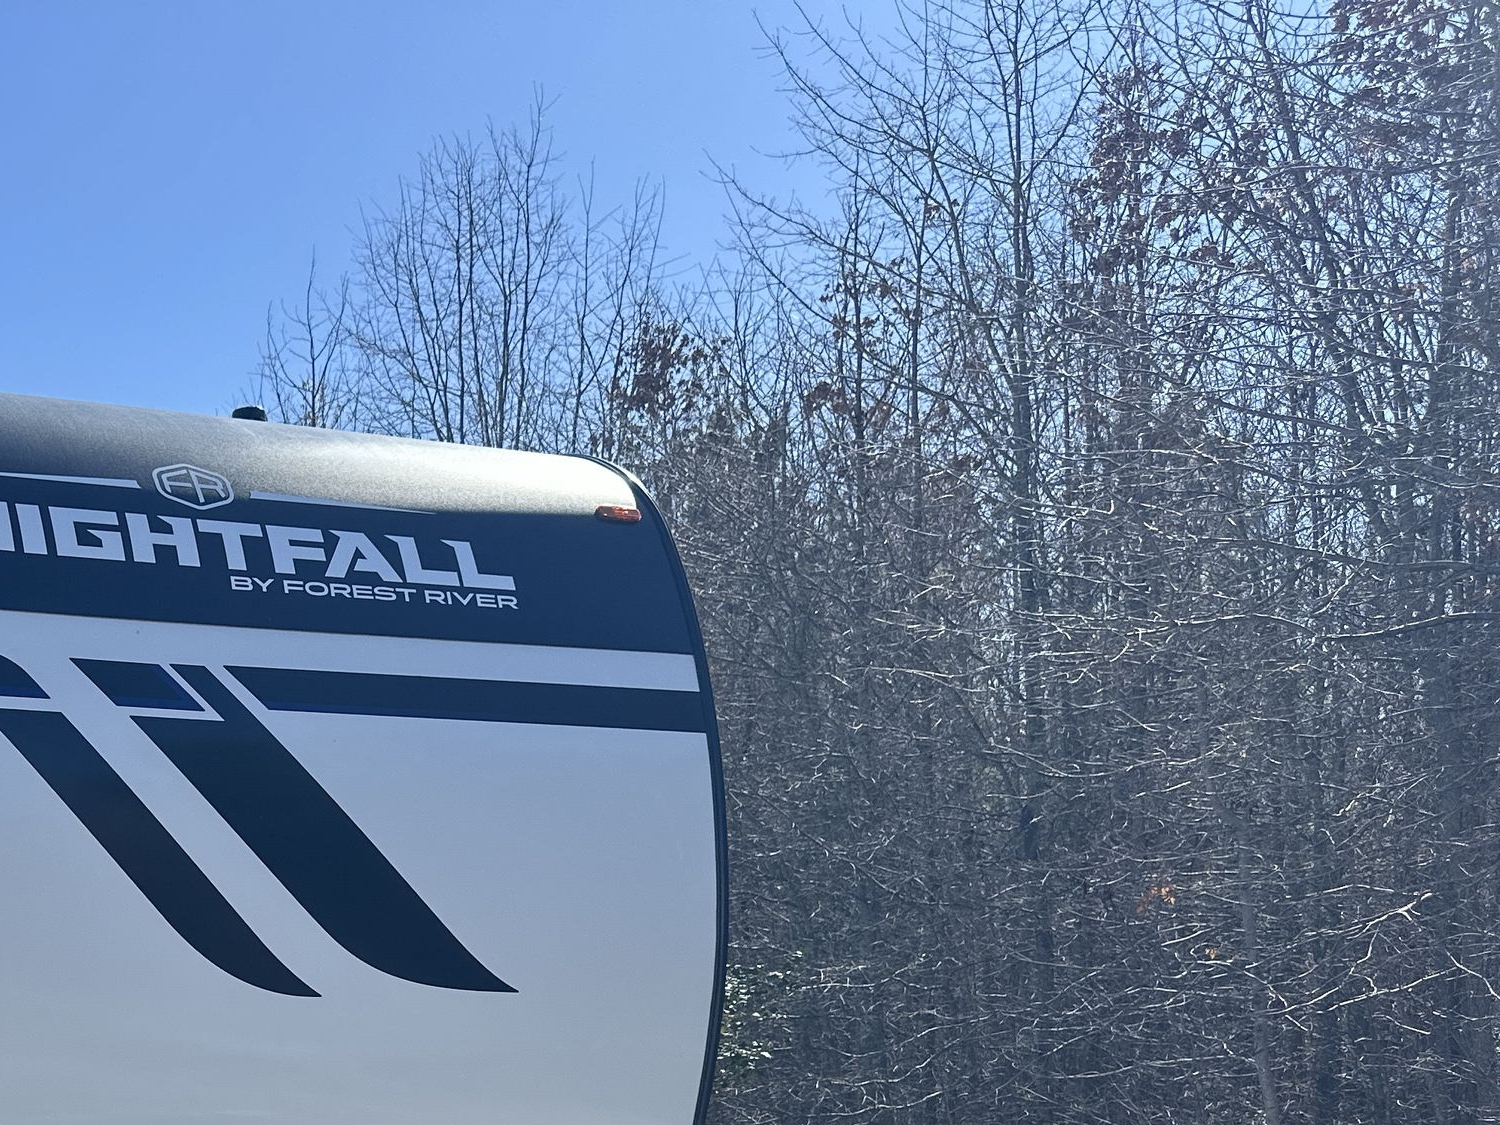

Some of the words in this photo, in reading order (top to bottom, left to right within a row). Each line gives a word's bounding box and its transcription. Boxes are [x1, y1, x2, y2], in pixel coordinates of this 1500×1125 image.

[230, 575, 273, 596] BY
[283, 579, 418, 604] FOREST
[425, 591, 520, 610] RIVER
